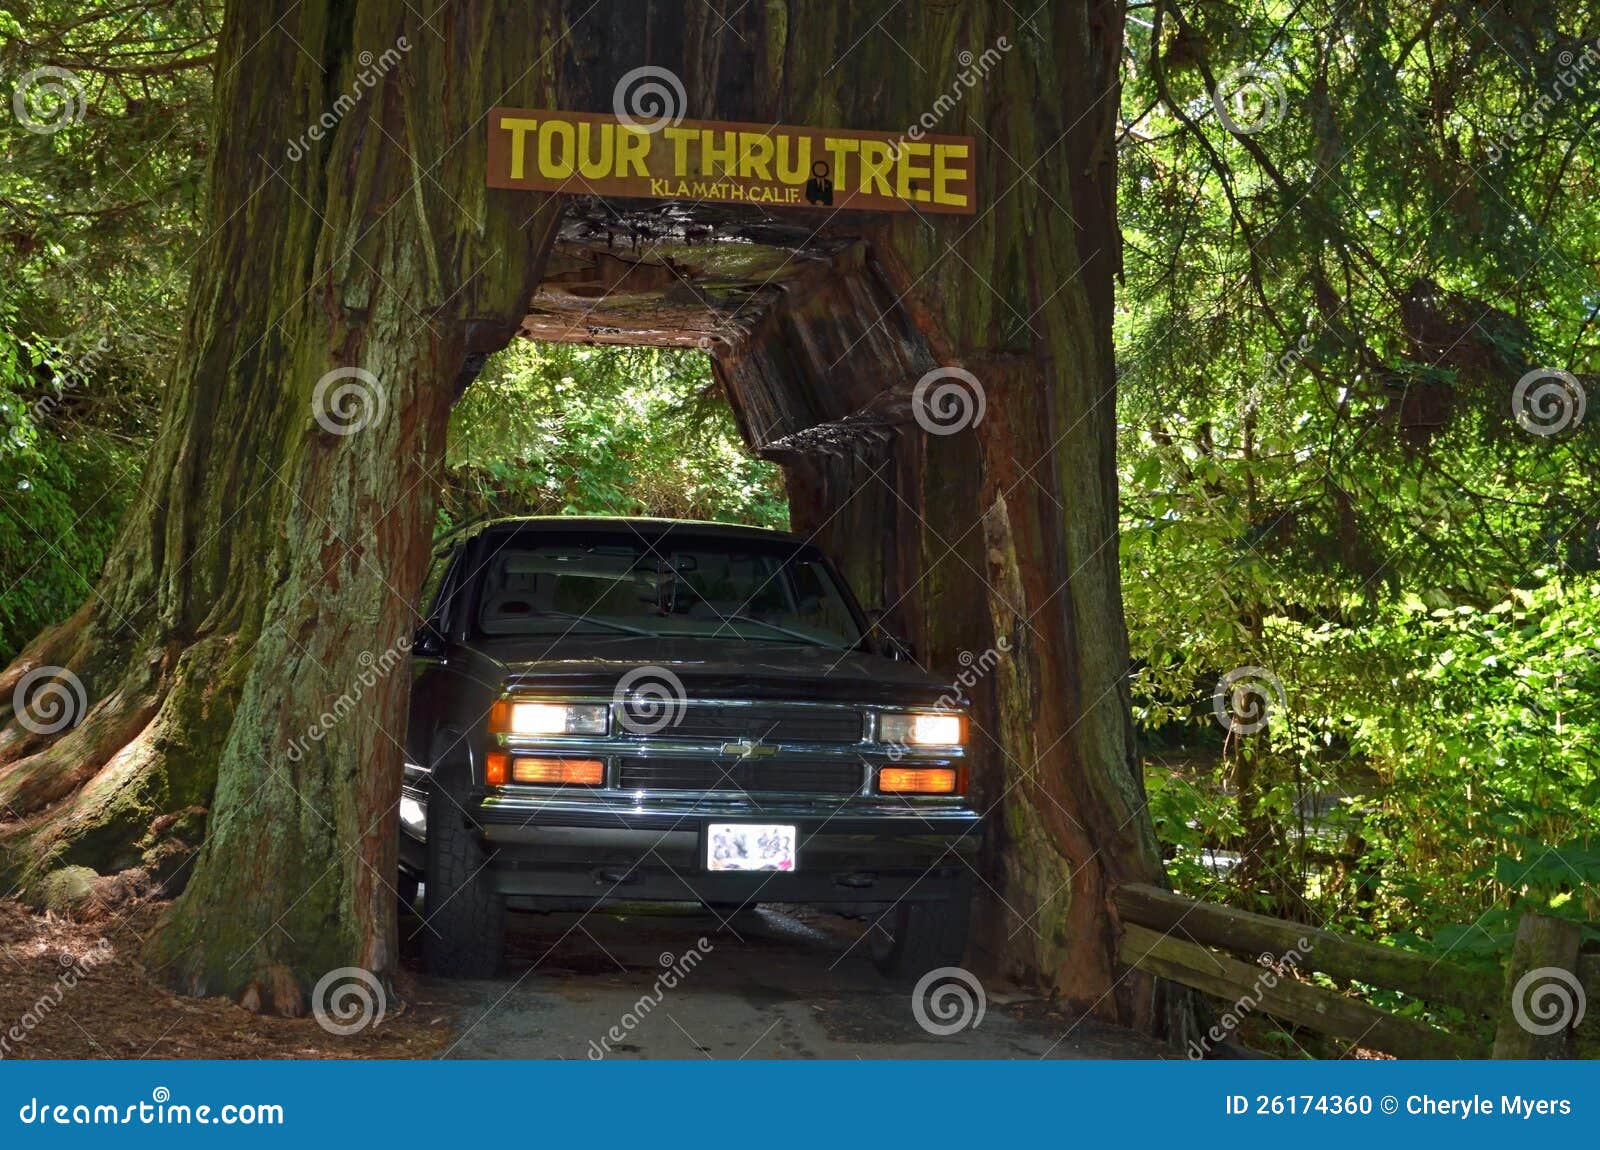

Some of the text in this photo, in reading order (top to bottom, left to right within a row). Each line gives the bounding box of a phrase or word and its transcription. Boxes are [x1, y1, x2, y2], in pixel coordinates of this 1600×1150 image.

[501, 117, 968, 207] TOUR THRU TREE
